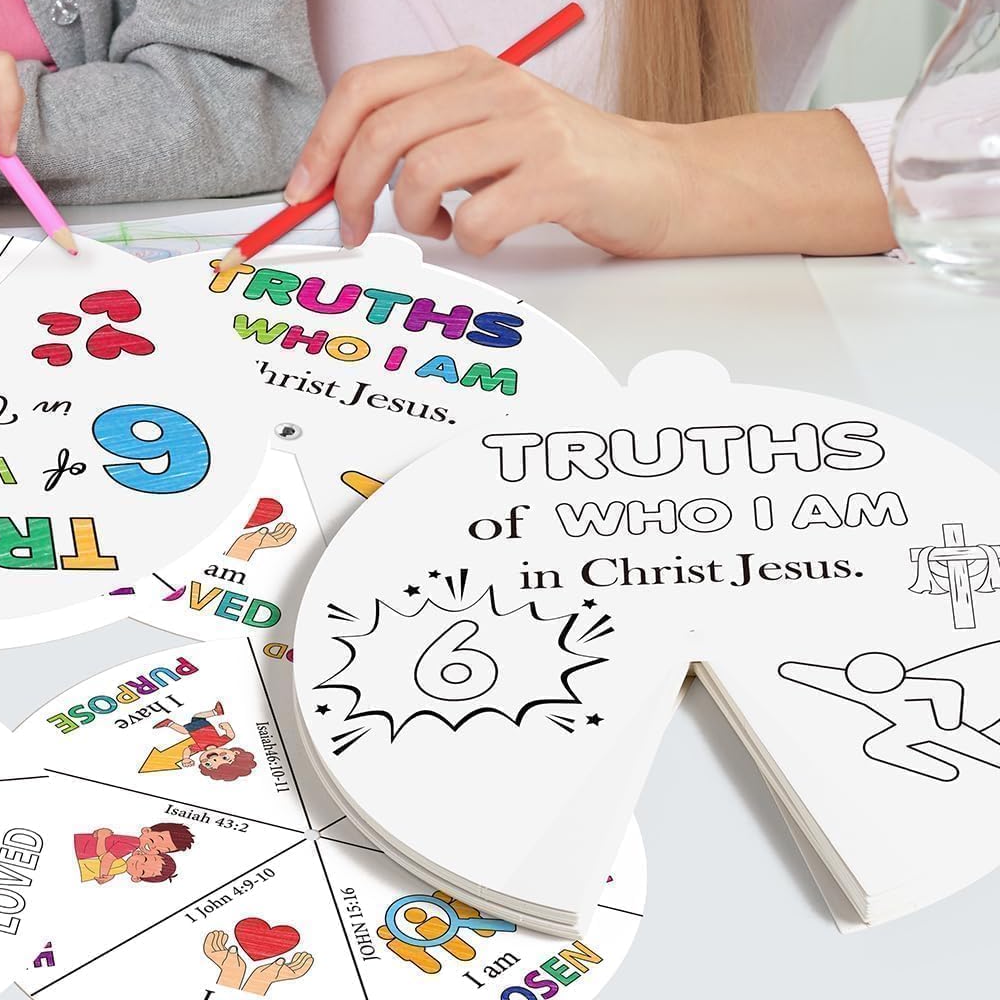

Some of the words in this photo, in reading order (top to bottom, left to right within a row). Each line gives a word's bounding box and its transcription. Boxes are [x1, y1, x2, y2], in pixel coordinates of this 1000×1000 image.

[209, 258, 525, 349] TRUTHS
[233, 314, 371, 362] WHO
[384, 346, 408, 372] I
[415, 355, 519, 396] AM
[33, 399, 73, 417] in
[256, 360, 341, 398] hrist
[339, 381, 456, 425] Jesus.
[42, 447, 87, 492] of
[91, 403, 211, 495] 6
[481, 420, 886, 483] TRUTHS
[468, 505, 530, 541] of
[554, 497, 733, 538] WHO
[753, 496, 773, 531] I
[792, 491, 909, 530] AM
[203, 564, 247, 585] am
[520, 561, 561, 590] in
[581, 555, 725, 587] Christ
[731, 553, 864, 588] Jesus.
[163, 580, 282, 628] VED
[413, 619, 499, 702] 6
[46, 656, 199, 734] PURPOSE
[114, 700, 173, 730] have
[165, 693, 185, 708] I
[255, 720, 290, 794] Isaiah46:10-11
[164, 804, 212, 825] Isaiah
[214, 816, 250, 834] 43:2
[184, 912, 197, 924] 1
[196, 893, 234, 919] John
[232, 867, 277, 897] 4:9-10
[340, 887, 363, 921] 15:16
[351, 920, 382, 962] JOHN
[462, 971, 485, 989] I
[483, 952, 522, 979] am
